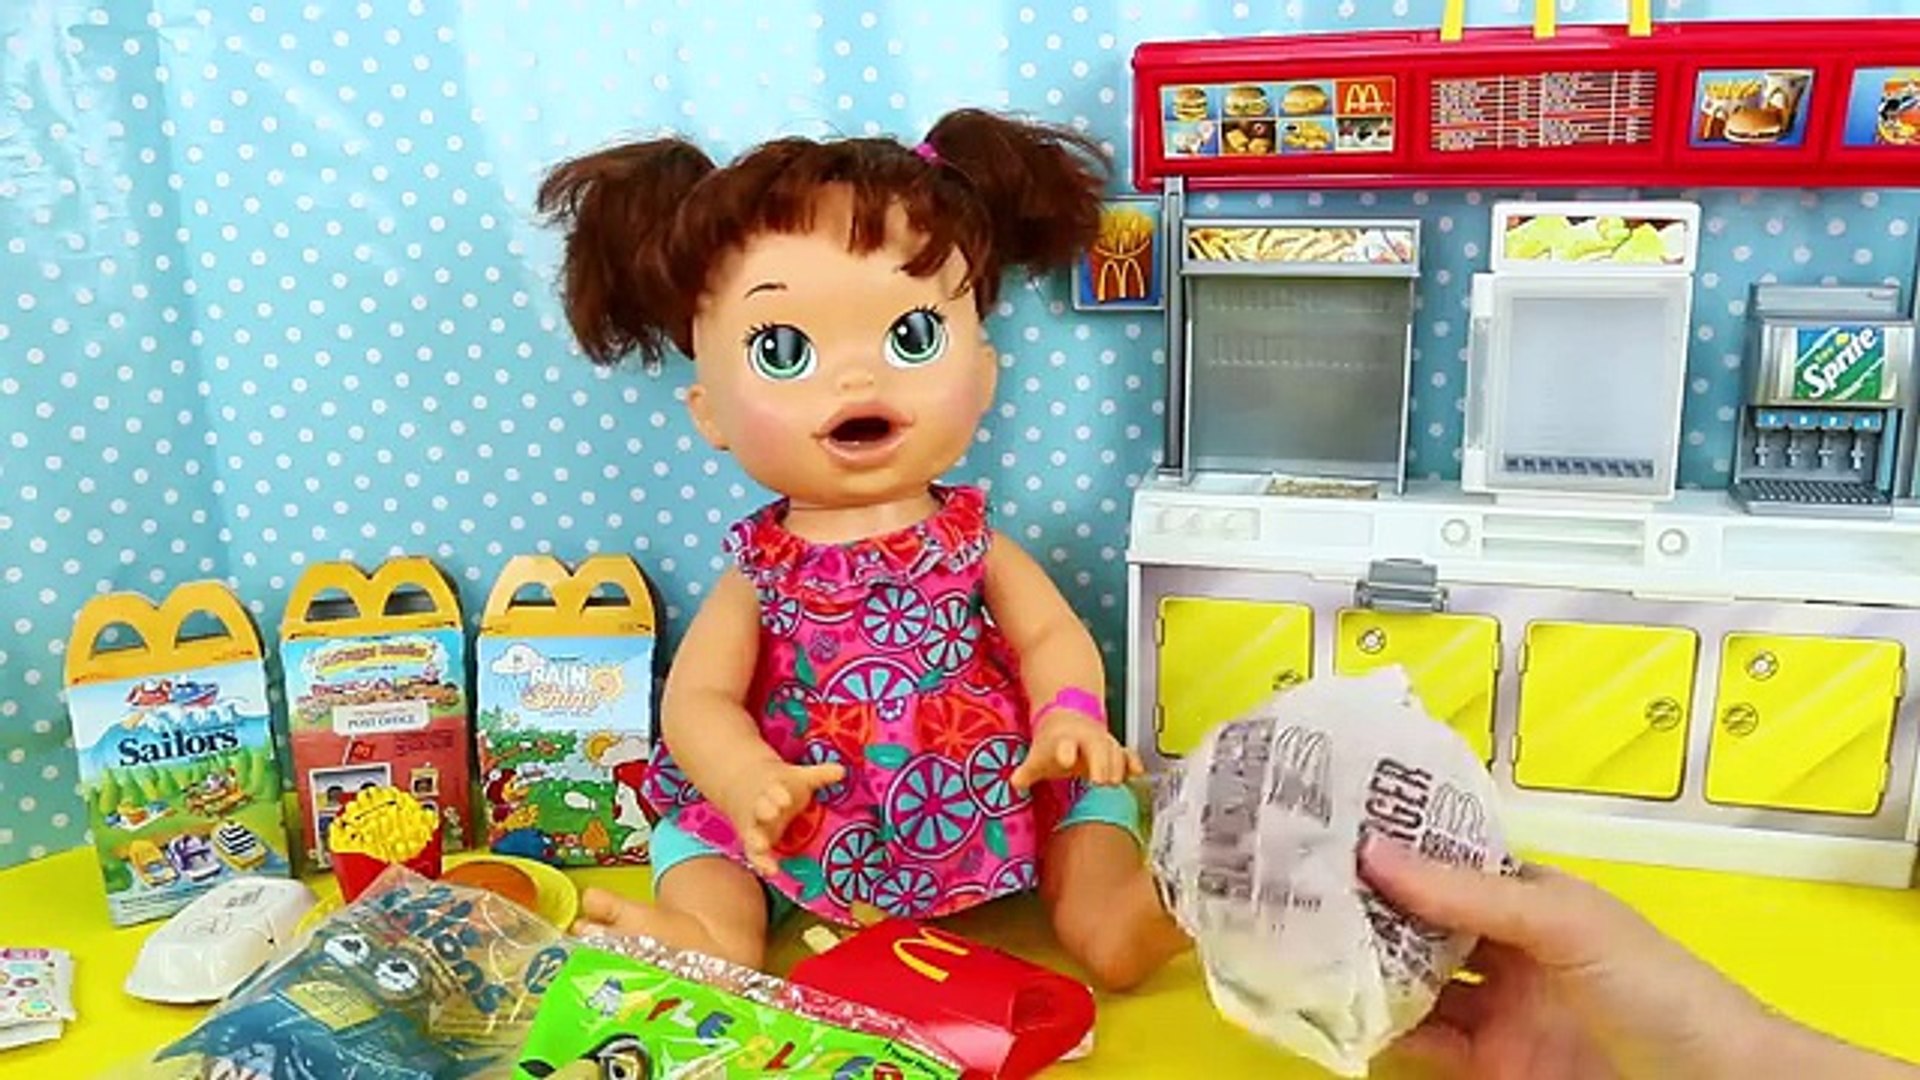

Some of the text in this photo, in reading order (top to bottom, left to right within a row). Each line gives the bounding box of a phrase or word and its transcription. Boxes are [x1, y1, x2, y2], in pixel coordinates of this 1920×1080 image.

[1802, 327, 1879, 398] Sprite
[530, 663, 590, 690] RAIN
[118, 728, 240, 767] Sailors
